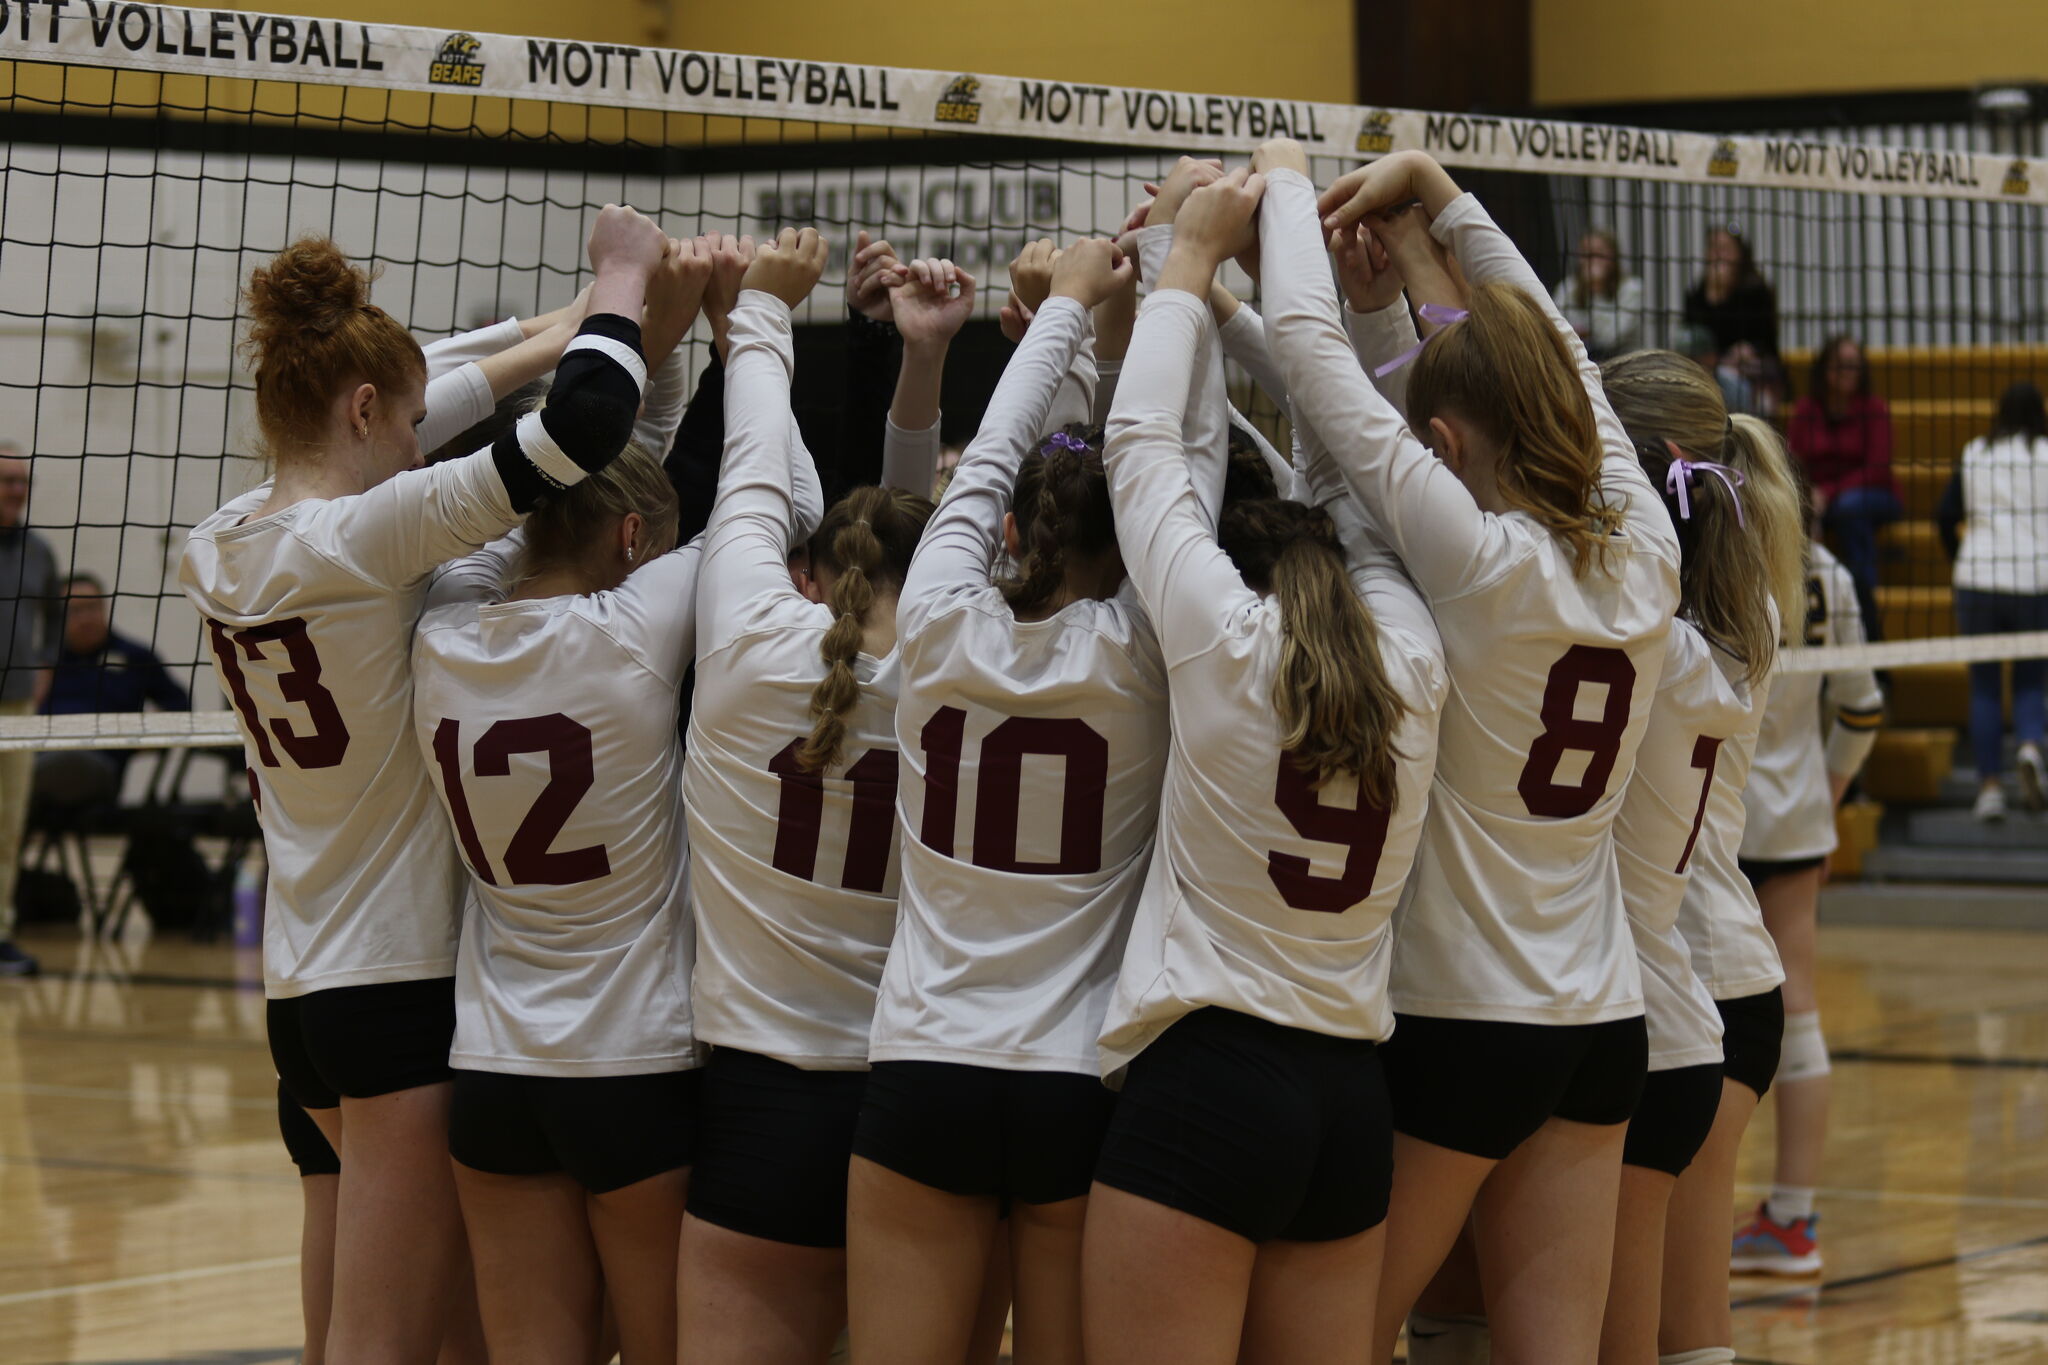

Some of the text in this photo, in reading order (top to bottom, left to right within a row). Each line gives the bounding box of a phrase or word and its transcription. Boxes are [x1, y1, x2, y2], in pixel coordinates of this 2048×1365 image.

[85, 0, 383, 70] VOLLEYBALL
[430, 63, 482, 85] BEARS
[527, 39, 899, 110] MOTT VOLLEYBALL
[1019, 81, 1325, 141] MOTT VOLLEYBALL
[1424, 113, 1679, 167] MOTT VOLLEYBALL
[1764, 141, 1828, 176] MOTT
[1836, 146, 1979, 187] VOLLEYBALL
[924, 178, 1059, 227] CLUB
[206, 616, 350, 769] 13
[1517, 643, 1637, 818] 8
[432, 712, 612, 886] 12
[767, 736, 899, 893] 11
[920, 704, 1109, 875] 10
[1267, 748, 1396, 914] 9
